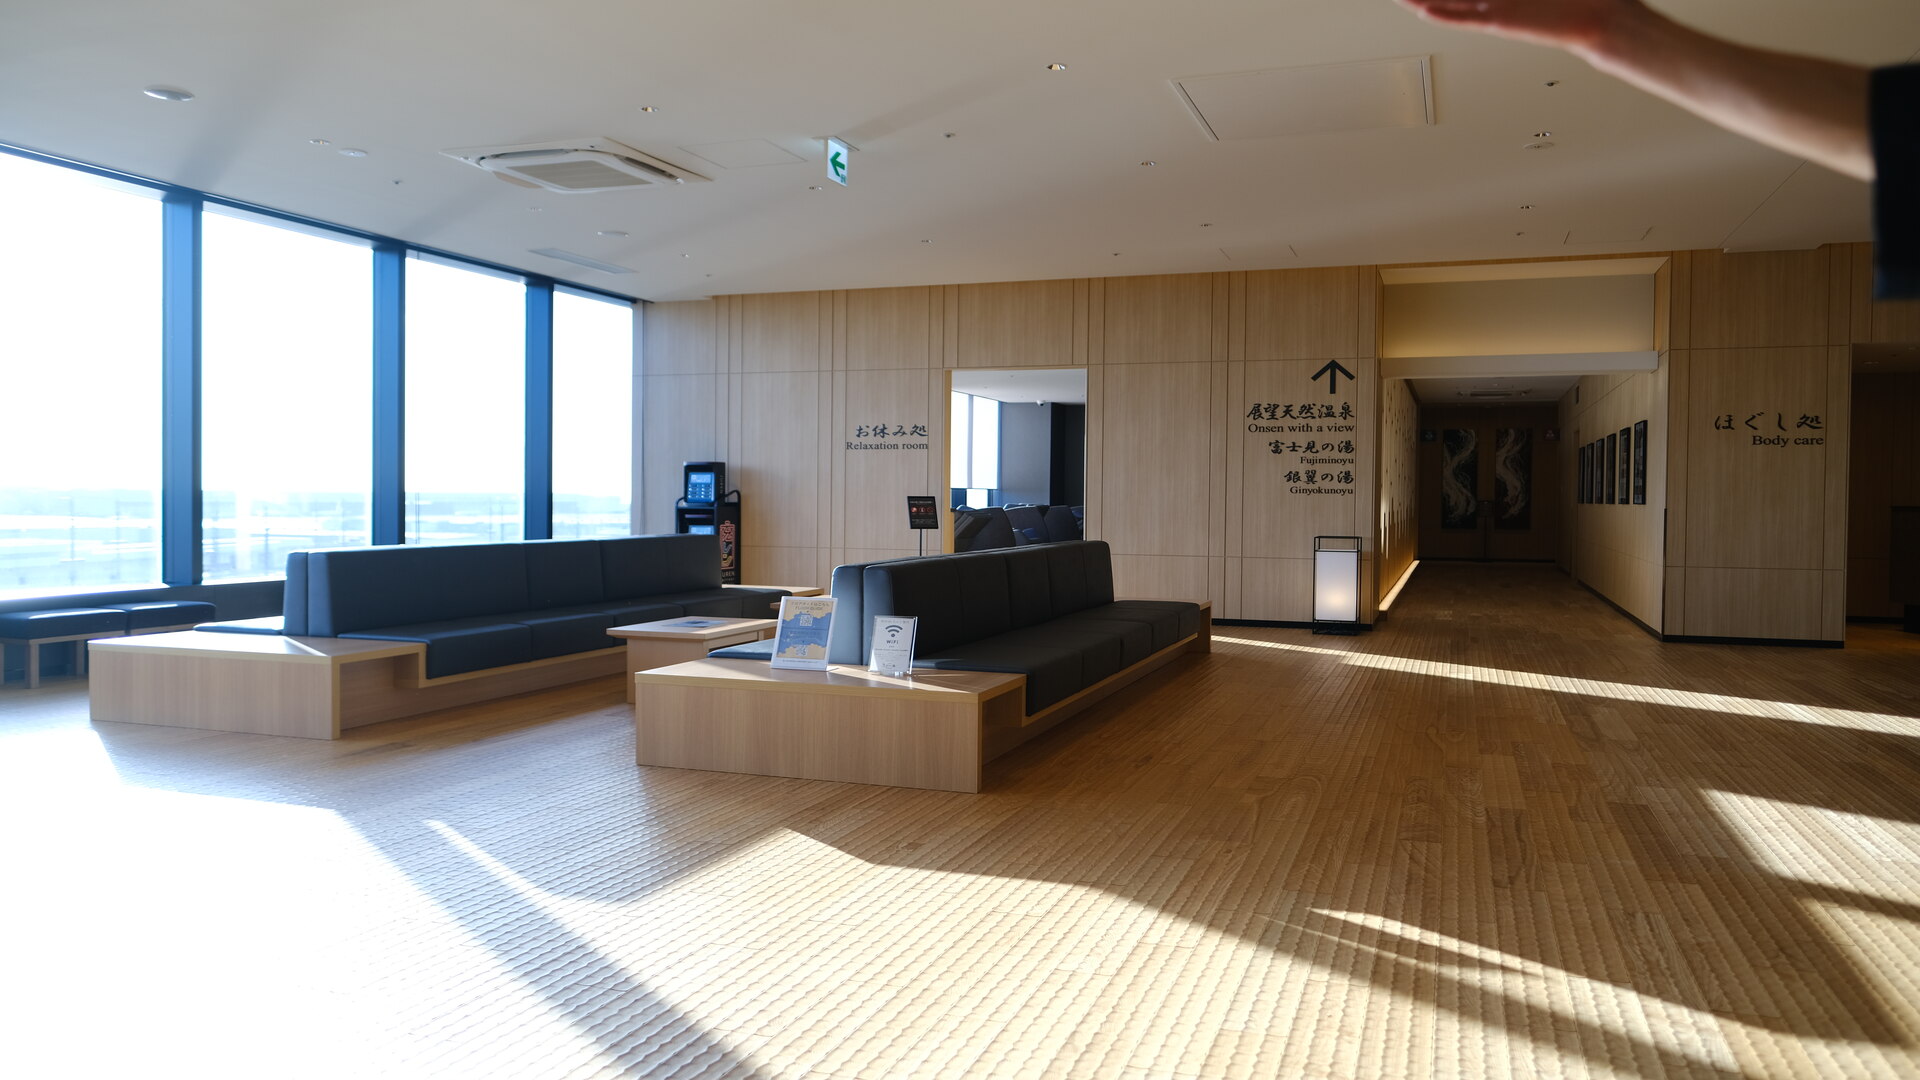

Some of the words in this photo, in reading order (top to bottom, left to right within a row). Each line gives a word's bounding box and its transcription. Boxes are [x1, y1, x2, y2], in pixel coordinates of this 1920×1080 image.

[1247, 402, 1355, 420] 展望天然温泉
[1248, 423, 1284, 433] Onsen
[1288, 423, 1313, 432] with
[1326, 423, 1355, 432] view
[1714, 412, 1825, 431] ほぐし処
[856, 423, 929, 438] お休み処
[846, 441, 899, 450] Relaxation
[902, 442, 929, 450] room
[1268, 440, 1355, 454] 富士見の湯
[1752, 435, 1789, 448] Body
[1794, 437, 1824, 445] care
[1300, 456, 1354, 465] Fujiminoyu
[1284, 469, 1354, 484] 銀翼の湯
[1290, 486, 1354, 496] Ginyokunoyu
